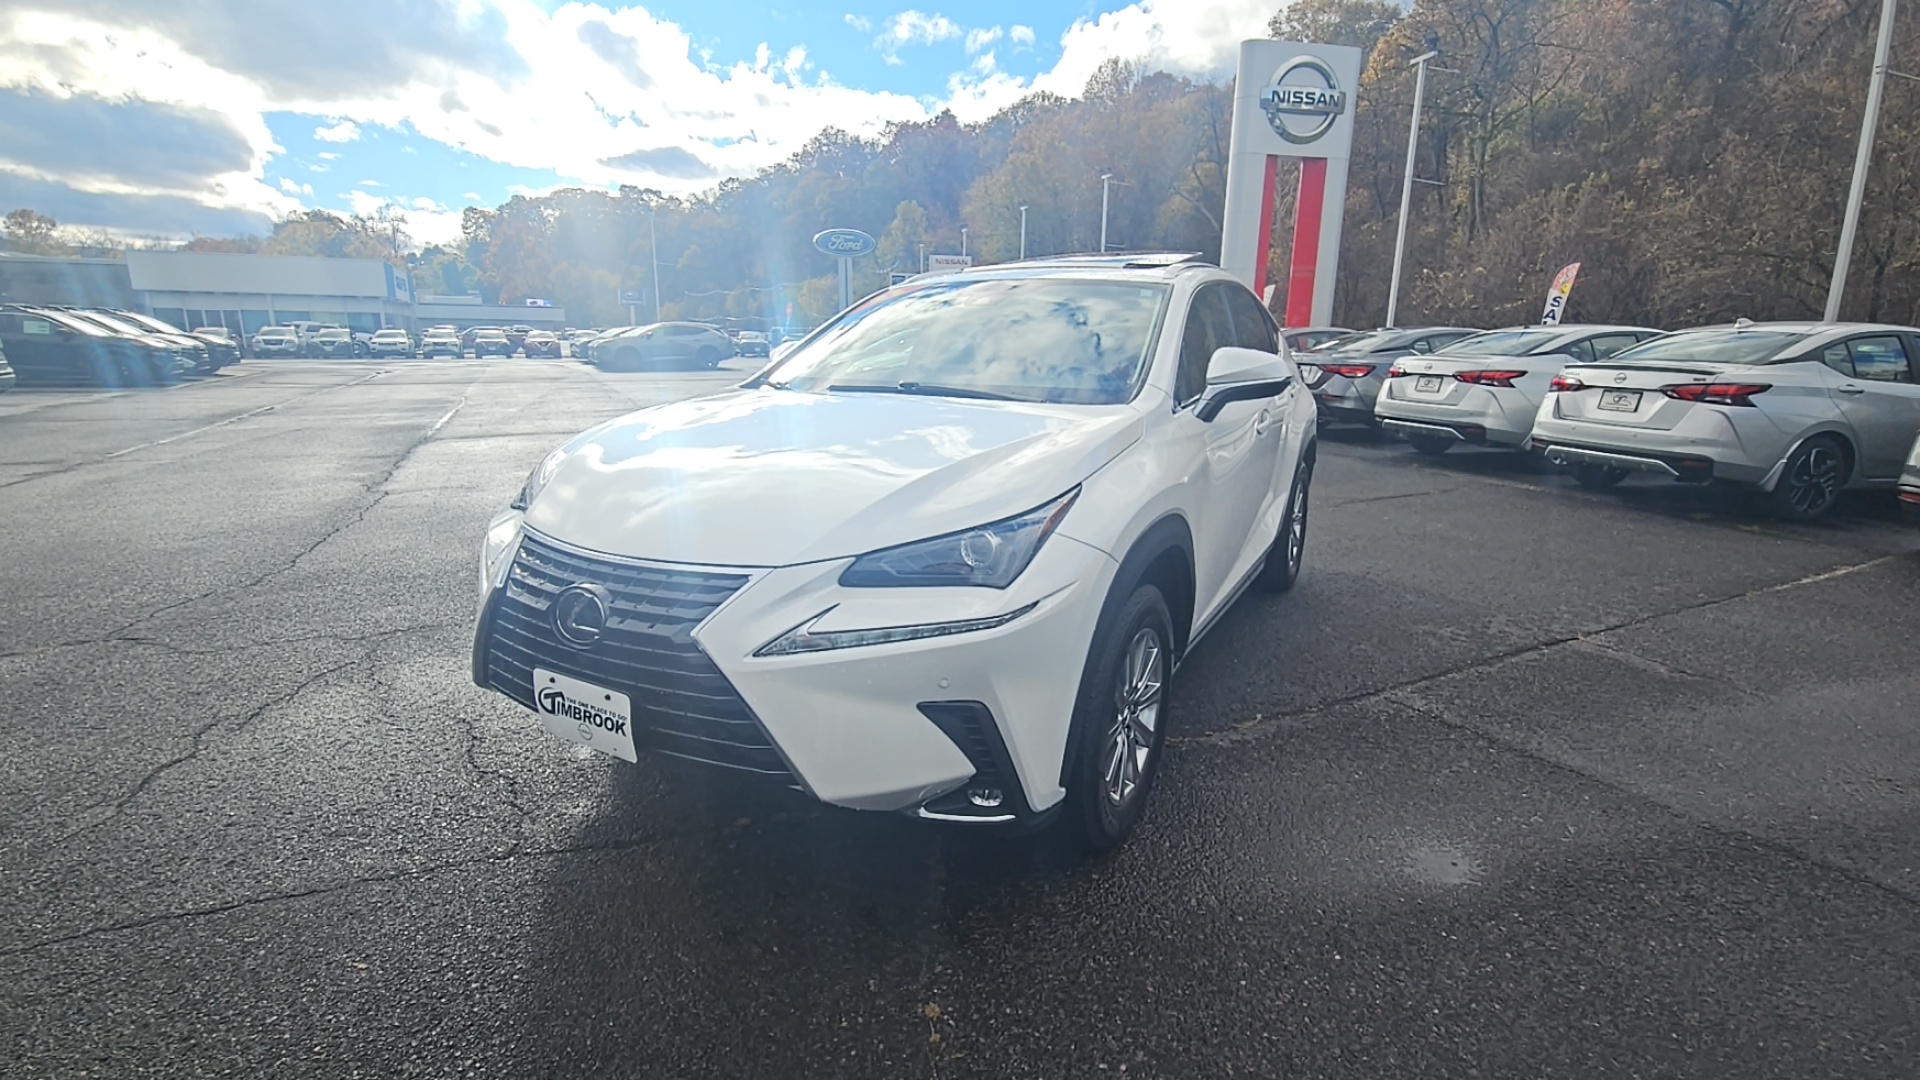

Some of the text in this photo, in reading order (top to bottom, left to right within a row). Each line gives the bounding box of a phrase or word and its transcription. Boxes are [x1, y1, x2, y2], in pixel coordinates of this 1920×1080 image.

[1271, 90, 1340, 107] NISSAN
[828, 234, 862, 250] Ford
[935, 258, 968, 266] NISSAN
[1543, 296, 1563, 325] SA
[539, 687, 627, 737] TIMBROOK
